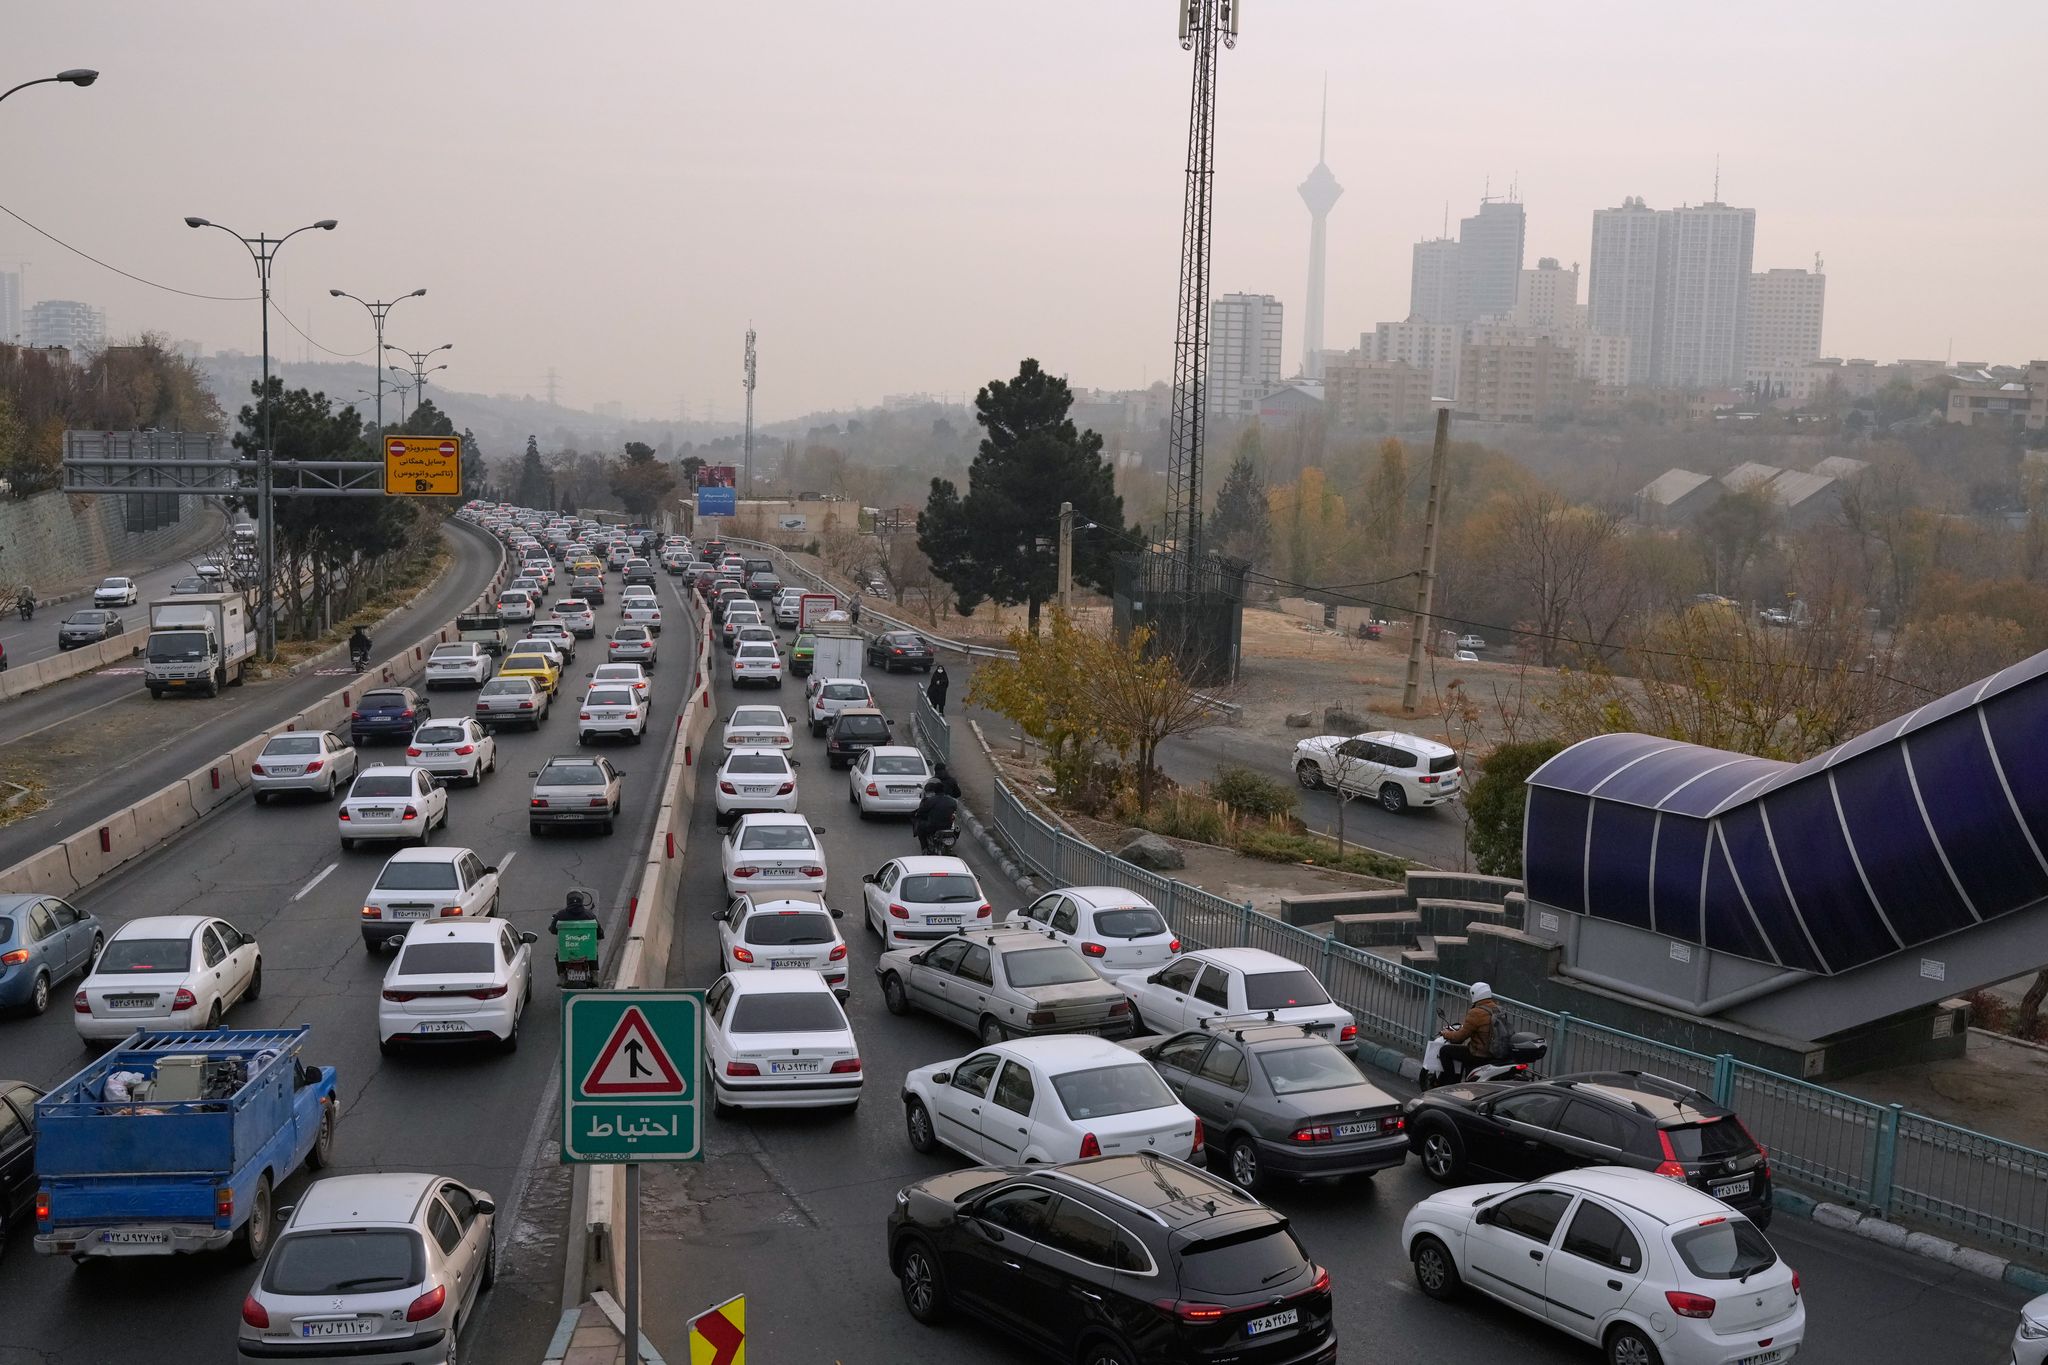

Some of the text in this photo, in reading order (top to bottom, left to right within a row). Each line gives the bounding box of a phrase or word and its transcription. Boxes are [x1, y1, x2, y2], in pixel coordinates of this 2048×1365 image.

[405, 444, 420, 453] ویژه
[400, 457, 446, 466] وسایل همگانی
[586, 1114, 678, 1143] احتیاط
